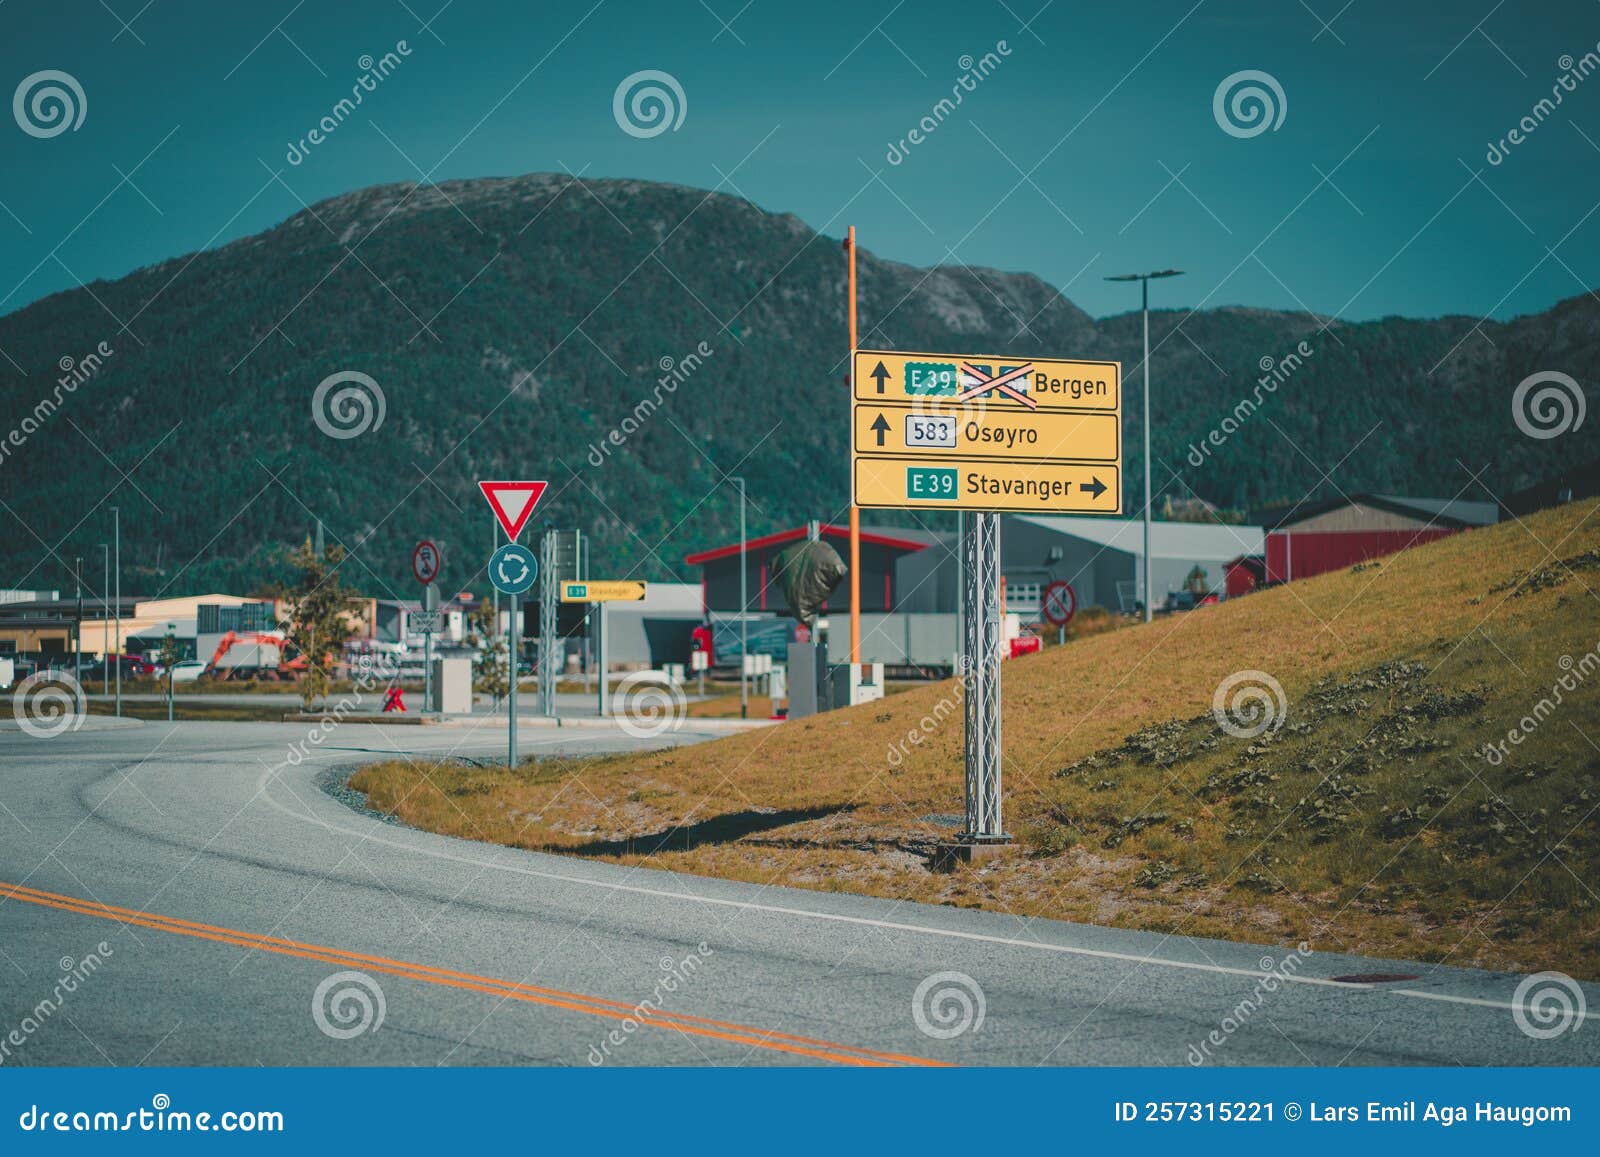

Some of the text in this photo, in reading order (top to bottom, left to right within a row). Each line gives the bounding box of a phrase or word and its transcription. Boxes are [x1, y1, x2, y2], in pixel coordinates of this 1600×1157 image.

[1034, 372, 1107, 399] Bergen
[913, 421, 1038, 449] 583 Osøyro
[966, 473, 1072, 500] Stavanger
